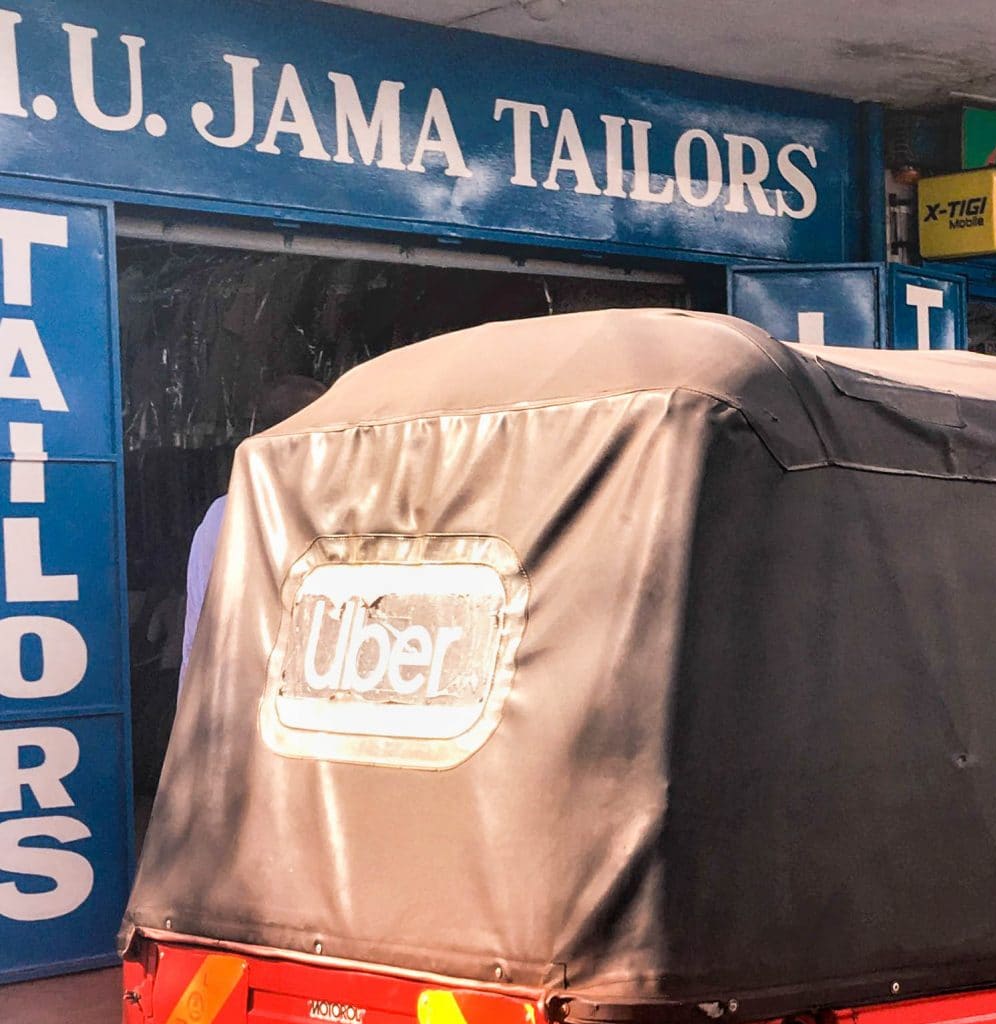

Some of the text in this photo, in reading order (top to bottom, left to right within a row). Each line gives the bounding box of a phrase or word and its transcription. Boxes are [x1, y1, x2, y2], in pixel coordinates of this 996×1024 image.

[191, 53, 473, 179] JAMA
[492, 98, 818, 220] TAILORS
[923, 196, 988, 222] X-TIGI
[949, 217, 985, 230] Mobile
[0, 209, 95, 921] TAILORS
[303, 597, 463, 699] Uber
